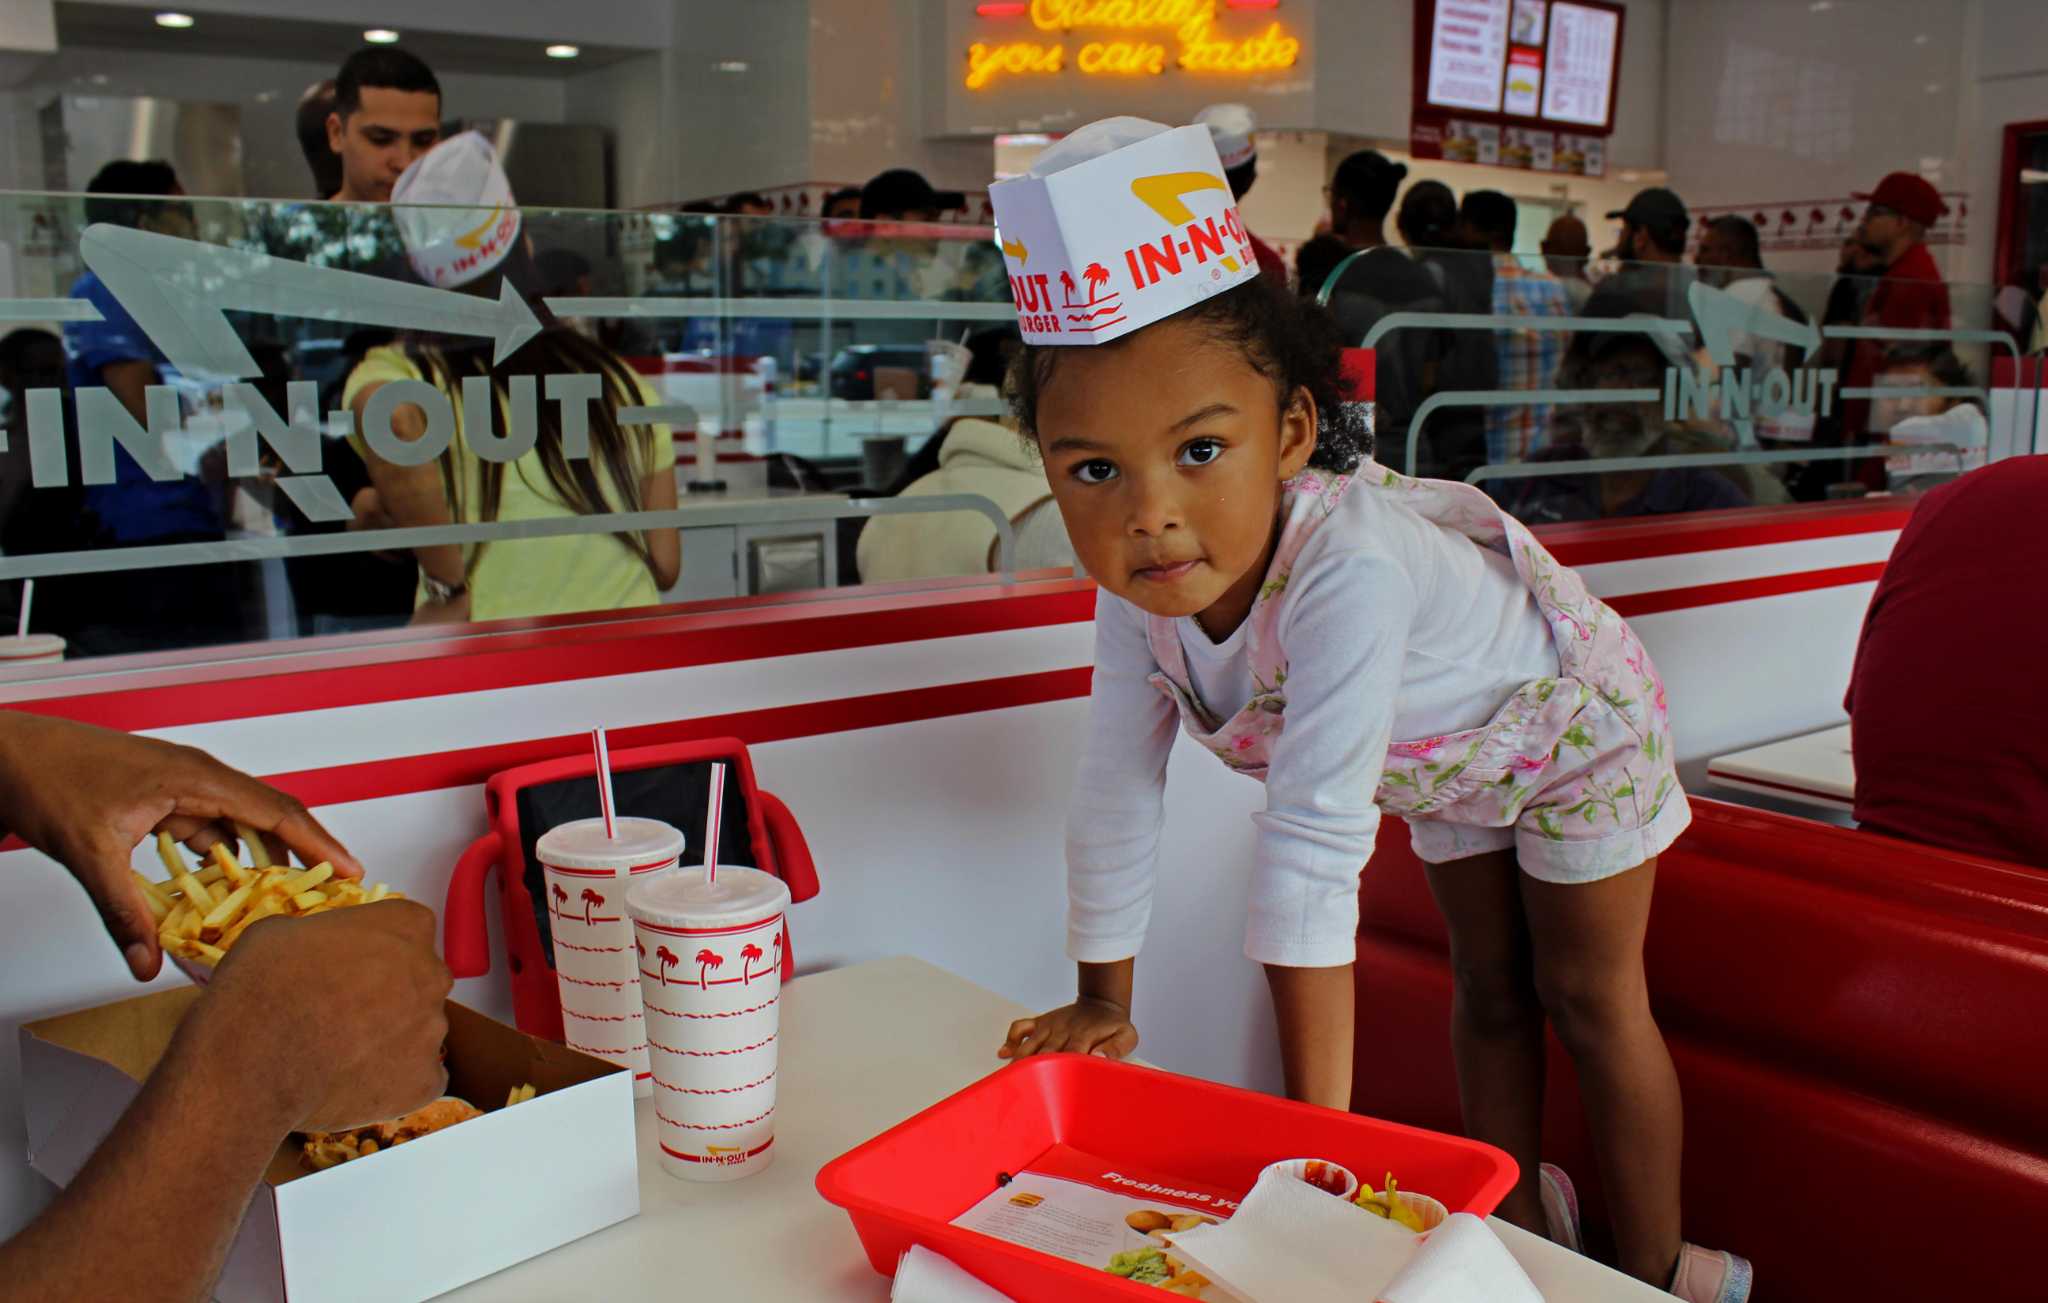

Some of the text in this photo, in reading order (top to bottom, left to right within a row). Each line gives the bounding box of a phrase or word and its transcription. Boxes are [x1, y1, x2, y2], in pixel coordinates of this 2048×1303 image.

[965, 21, 1300, 89] you can taste
[1664, 367, 1839, 421] IN-N-OUT
[701, 1152, 747, 1164] IN-N-OUT
[1101, 1171, 1240, 1209] Freshness yo
